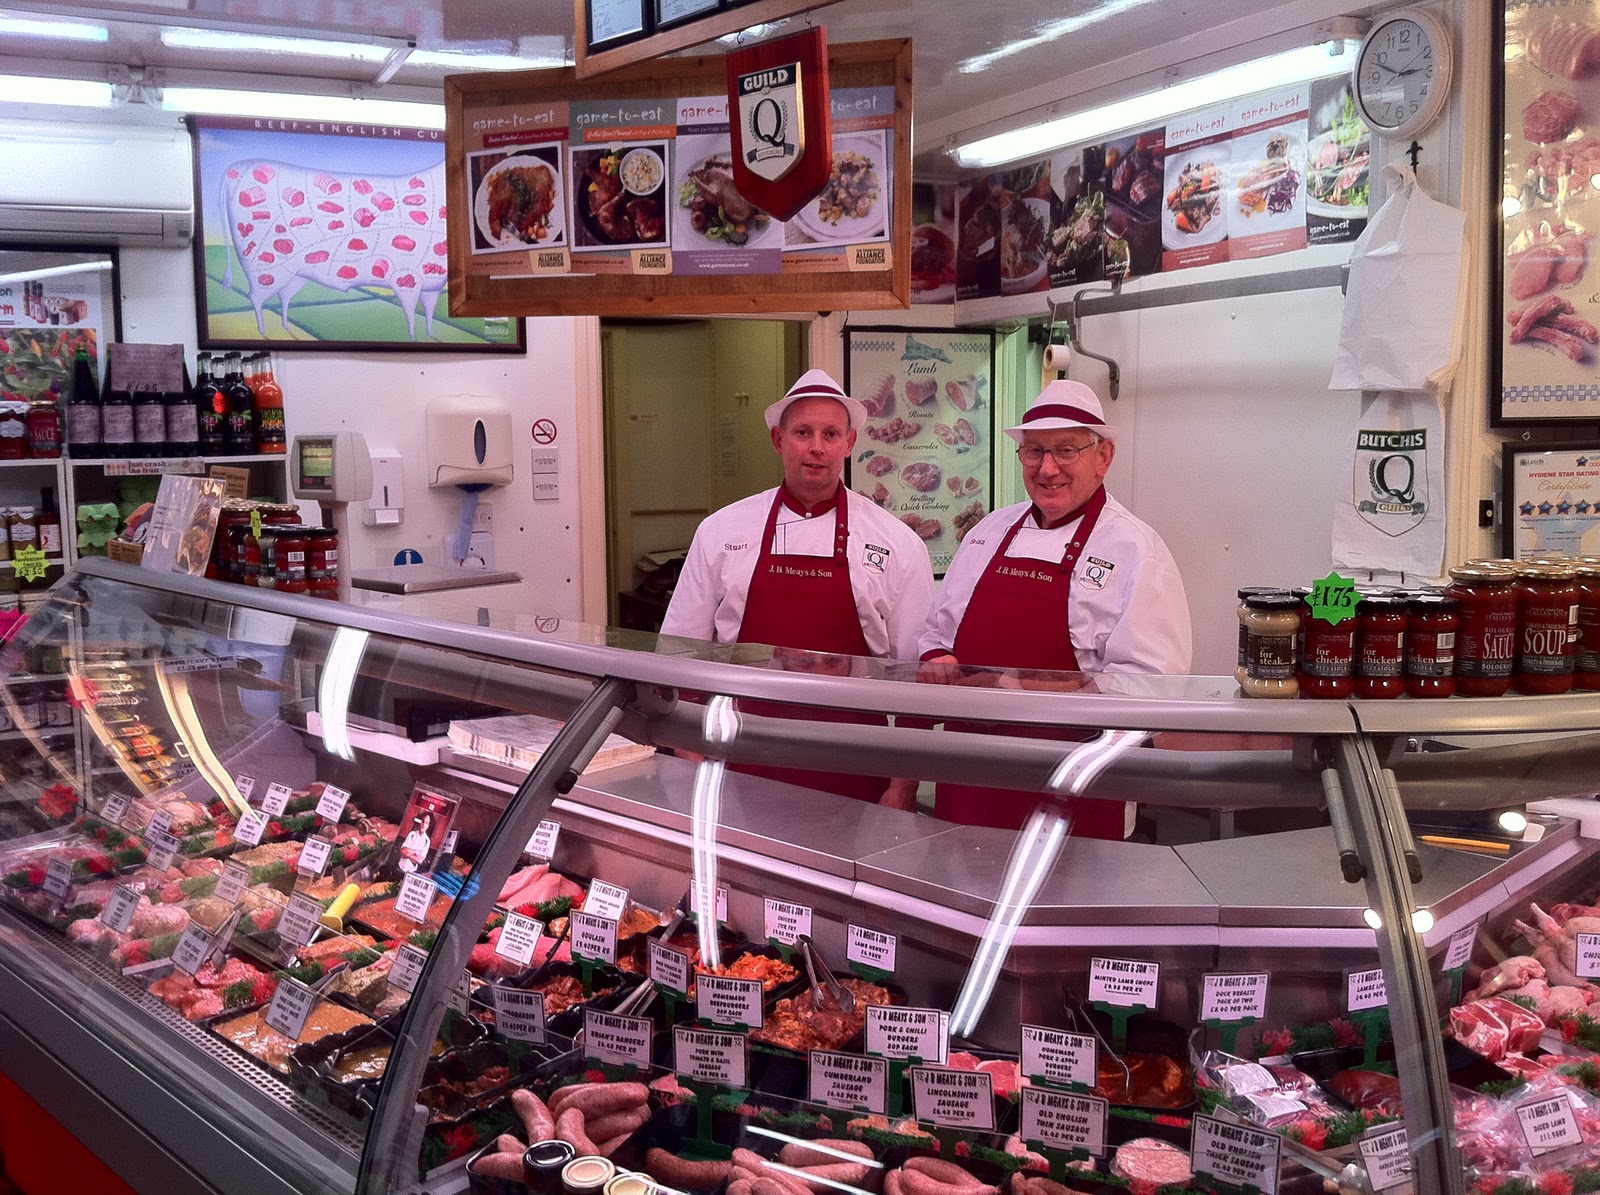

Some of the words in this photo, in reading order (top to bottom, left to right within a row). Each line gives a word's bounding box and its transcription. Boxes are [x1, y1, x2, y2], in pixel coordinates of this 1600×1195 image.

[743, 69, 788, 91] GUILD
[681, 105, 730, 124] game-t
[1240, 94, 1300, 126] game-to-eat
[473, 109, 556, 136] game-to-eat
[576, 106, 664, 130] game-to-eat
[752, 98, 785, 147] Q
[1170, 116, 1226, 141] game-to-eat
[417, 130, 438, 140] CU
[1309, 220, 1350, 234] game-to-eat
[904, 362, 938, 376] Lamb
[1376, 454, 1415, 503] Q
[1538, 478, 1592, 499] Certificate
[900, 503, 920, 512] Quick
[922, 502, 950, 512] Cooking
[1379, 503, 1412, 512] GUILD
[724, 542, 748, 551] Stuart
[1090, 557, 1112, 568] GUILD
[785, 566, 809, 577] Meays
[810, 568, 816, 576] &
[818, 569, 832, 578] Son
[1030, 570, 1036, 578] &
[1036, 572, 1053, 582] Son
[1524, 628, 1566, 655] SOUP
[1260, 649, 1274, 658] for
[1316, 646, 1330, 656] for
[1363, 647, 1376, 656] for
[1316, 656, 1348, 664] chicken
[1362, 656, 1396, 664] chicken
[778, 916, 796, 924] CHICKEN
[582, 932, 606, 942] GOULASH
[1136, 964, 1147, 973] SON
[739, 982, 750, 992] SON
[1247, 977, 1257, 986] SON
[1357, 984, 1375, 992] LAMBS
[713, 994, 746, 1002] HOMEMADE
[710, 1000, 749, 1010] BEEFBURGERS
[914, 1014, 926, 1024] SON
[628, 1020, 638, 1032] SON
[879, 1024, 897, 1032] PORK
[591, 1030, 614, 1040] BRIAN'S
[616, 1036, 645, 1046] BANGERS
[720, 1036, 732, 1047] SON
[888, 1034, 919, 1042] BURGERS
[1070, 1036, 1082, 1048] SON
[1039, 1053, 1054, 1061] PORK
[1042, 1047, 1074, 1056] HOMEMADE
[860, 1060, 872, 1072] SON
[1046, 1062, 1072, 1071] BURGERS
[824, 1071, 872, 1084] CUMBERLAND
[964, 1076, 976, 1087] SON
[832, 1082, 863, 1092] SAUSAGE
[927, 1088, 978, 1100] LINCOLNSHIRE
[938, 1099, 969, 1108] SAUSAGE
[1076, 1100, 1090, 1112] SON
[1039, 1110, 1054, 1118] OLD
[1056, 1112, 1088, 1124] ENGLISH
[1037, 1119, 1054, 1128] THIN
[1056, 1123, 1090, 1134] SAUSAGE
[1534, 1122, 1550, 1132] DICED
[1551, 1118, 1566, 1127] LAMB
[1211, 1140, 1226, 1150] OLD
[1250, 1134, 1264, 1146] SON
[1230, 1156, 1265, 1171] SAUSAGE
